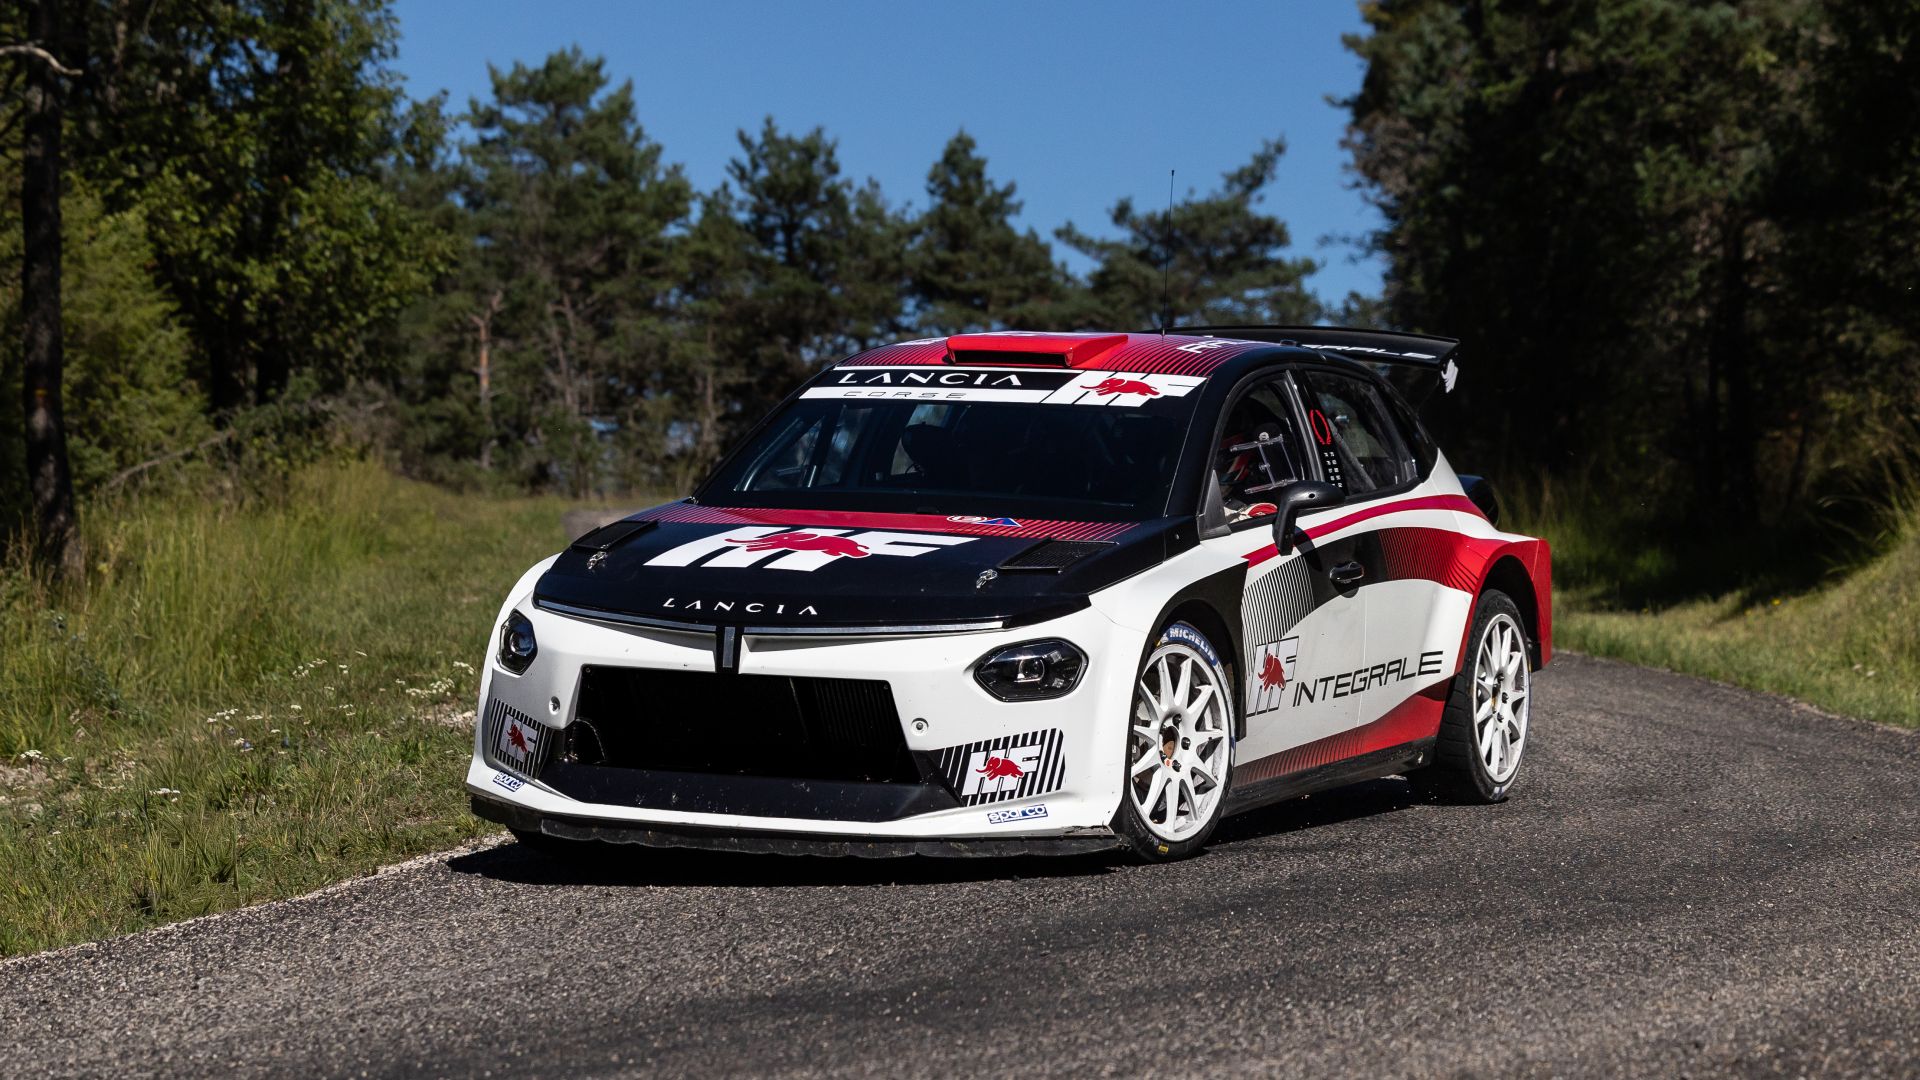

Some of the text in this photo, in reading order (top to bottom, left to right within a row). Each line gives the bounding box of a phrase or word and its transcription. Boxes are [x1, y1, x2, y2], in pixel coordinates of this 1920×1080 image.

[838, 372, 1021, 386] LANCIA
[843, 391, 966, 399] CORSE
[662, 597, 818, 615] LANCIA
[1169, 627, 1216, 661] MICHELIN
[1292, 651, 1444, 707] INTEGRALE
[988, 805, 1047, 823] sparco
